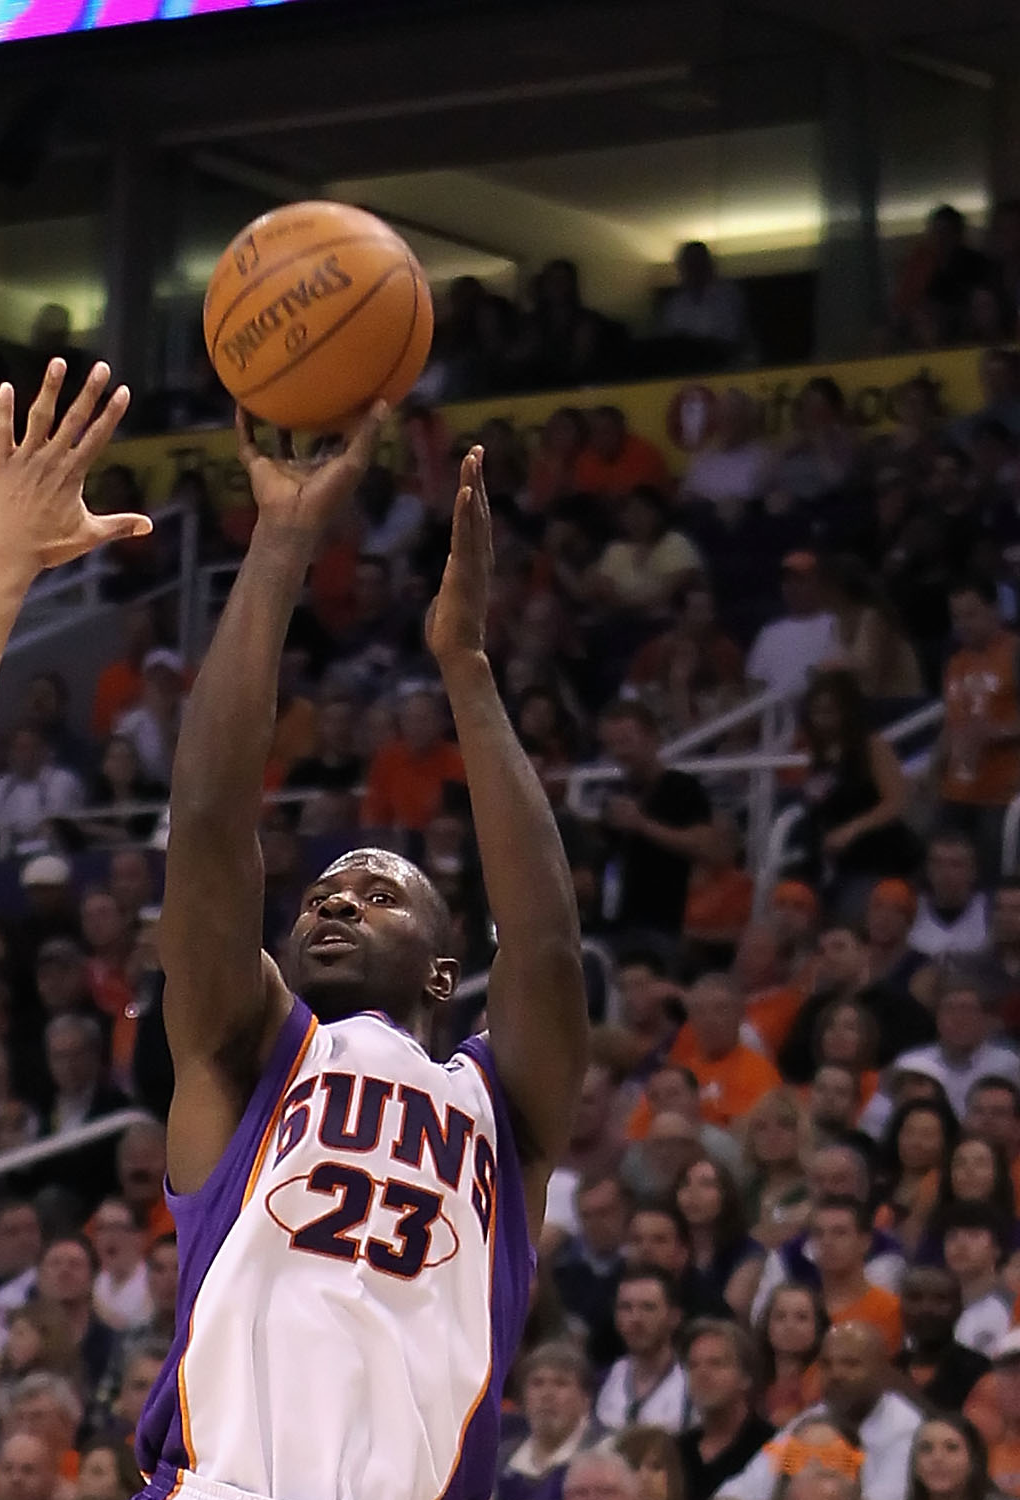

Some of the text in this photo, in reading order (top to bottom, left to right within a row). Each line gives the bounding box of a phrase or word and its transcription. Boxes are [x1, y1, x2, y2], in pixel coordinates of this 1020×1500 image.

[223, 252, 353, 373] SPALDING
[271, 1071, 497, 1246] SUNS
[289, 1161, 444, 1282] 23
